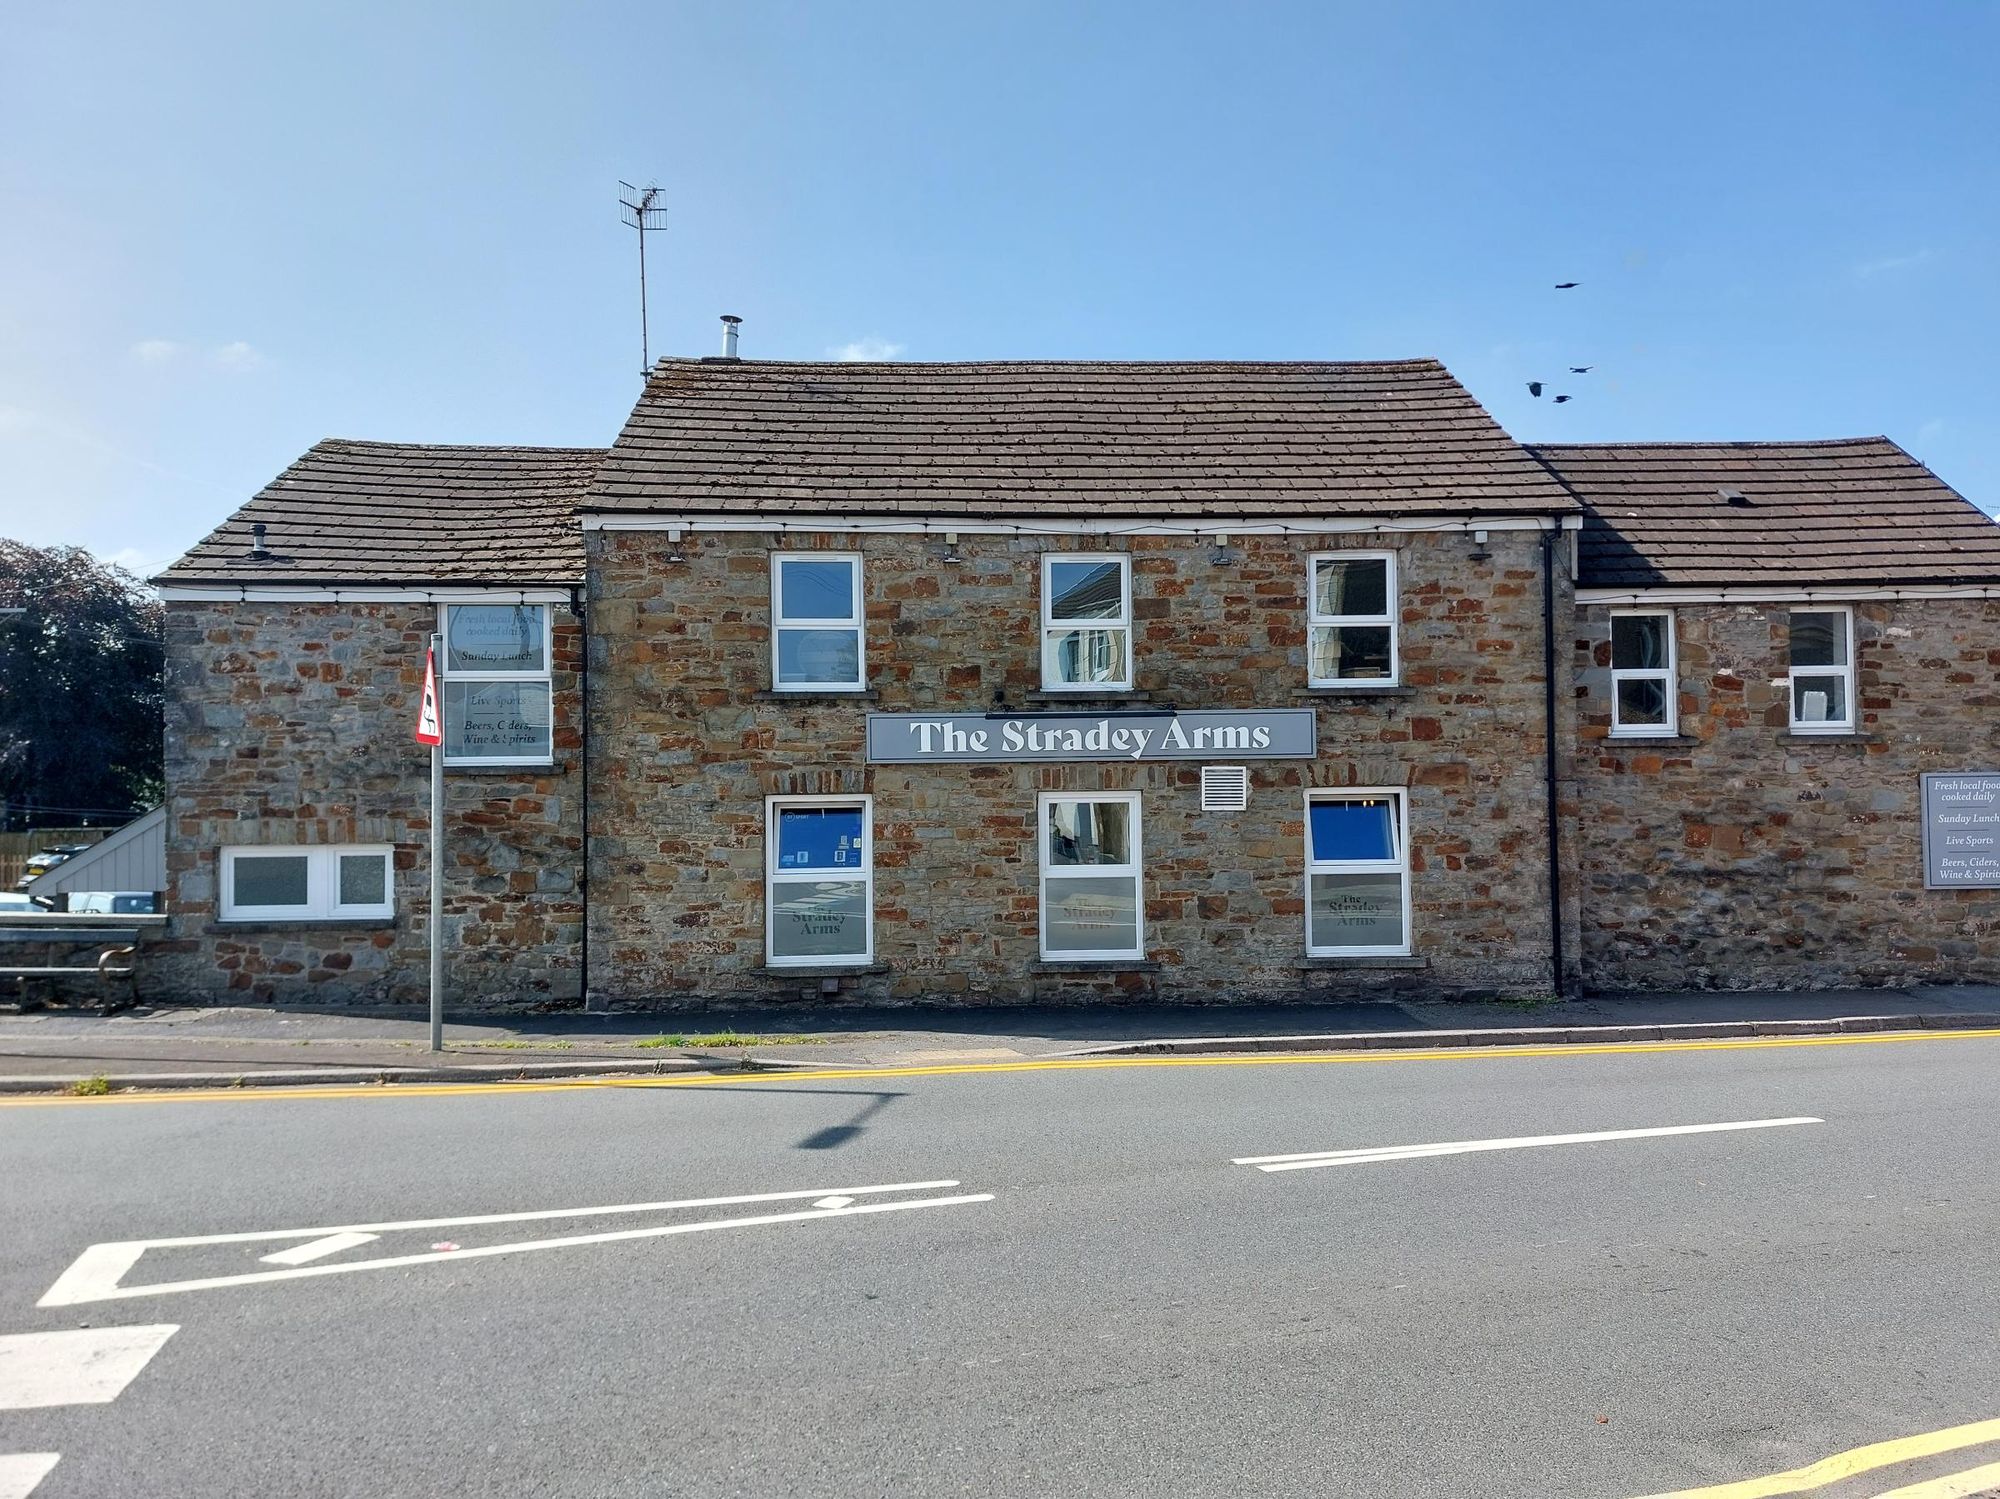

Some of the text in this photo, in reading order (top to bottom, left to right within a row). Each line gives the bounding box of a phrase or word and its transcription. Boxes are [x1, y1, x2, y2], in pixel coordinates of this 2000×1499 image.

[461, 650, 498, 662] Sunday
[464, 720, 532, 732] Beers, Cders,
[463, 734, 489, 744] Wine
[490, 734, 500, 744] &
[910, 718, 1271, 760] The Stradey Arms
[1935, 781, 1958, 790] Fresh
[1960, 780, 1981, 790] local
[1941, 791, 1995, 803] cooked daily
[1938, 812, 2000, 825] Sunday Lunch
[1946, 835, 1994, 847] Live Sports
[1941, 856, 2000, 868] Beers, Ciders,
[1940, 869, 1962, 879] Wine
[1964, 869, 1973, 878] &
[1341, 894, 1361, 903] The
[800, 922, 841, 935] Arms
